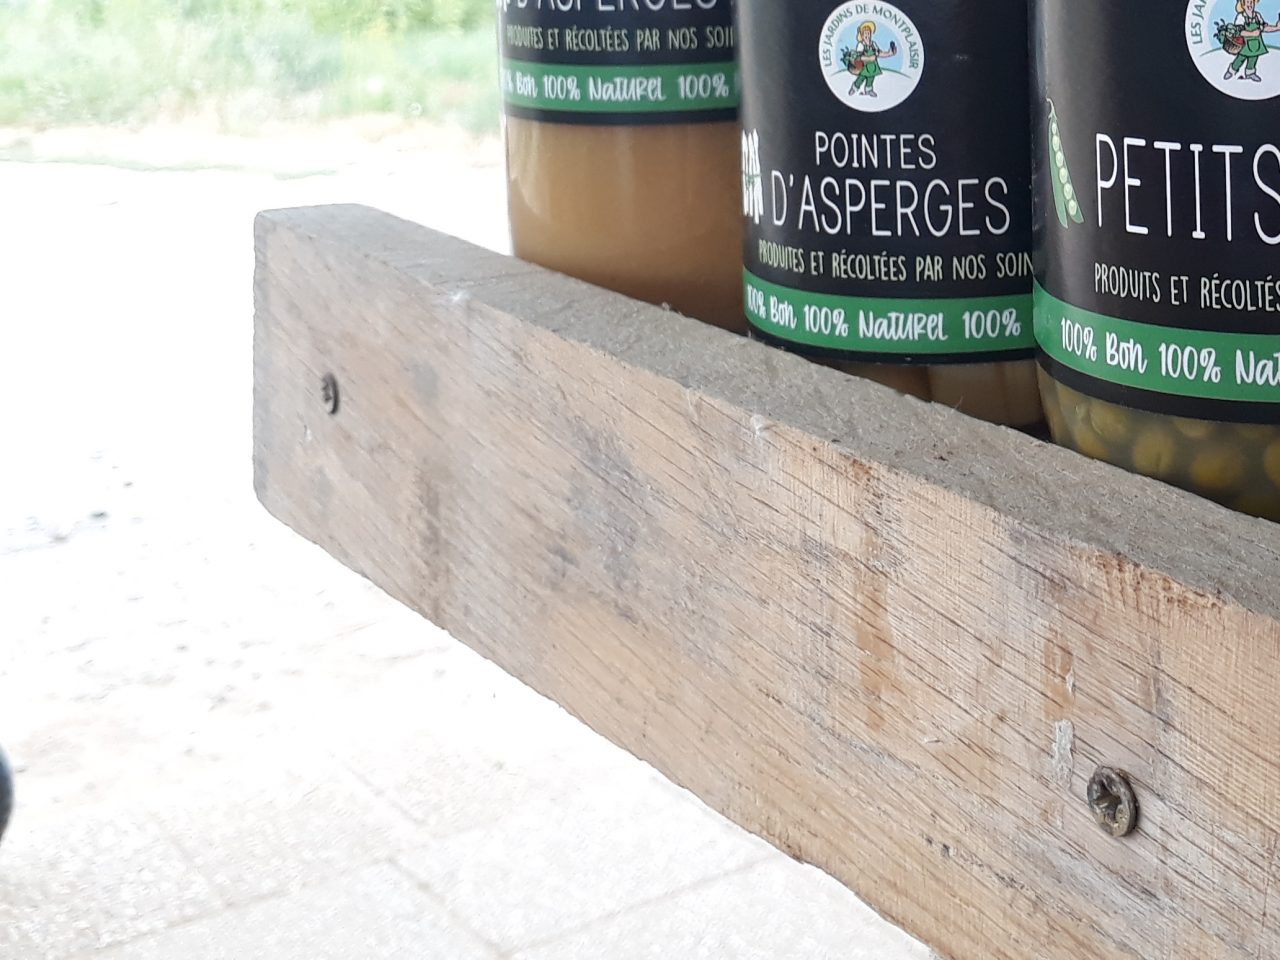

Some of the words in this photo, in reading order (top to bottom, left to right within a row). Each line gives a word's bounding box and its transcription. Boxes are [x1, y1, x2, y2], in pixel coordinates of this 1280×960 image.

[824, 7, 853, 47] JARDINS
[855, 4, 870, 15] DE
[547, 28, 559, 50] ET
[565, 24, 629, 52] RÉCOLTÉES
[636, 27, 660, 52] PAR
[668, 26, 698, 51] NOS
[872, 4, 920, 70] MONTPLAISIR
[1190, 21, 1203, 45] LES
[822, 48, 833, 67] LES
[543, 74, 581, 101] 100%
[678, 72, 730, 100] 100%
[815, 131, 937, 170] POINTES
[771, 170, 1011, 237] D'ASPERGES
[758, 238, 805, 274] PRODUITES
[810, 251, 825, 276] ET
[832, 249, 907, 282] RÉCOLTÉES
[915, 254, 943, 283] PAR
[952, 253, 987, 281] NOS
[1094, 261, 1161, 303] PRODUITS
[1169, 275, 1189, 306] ET
[769, 295, 798, 330] Bon
[803, 303, 850, 338] 100%
[962, 307, 1022, 339] 100%
[1060, 316, 1098, 363] 100%
[1105, 331, 1148, 375] Bon
[1158, 342, 1222, 384] 100%
